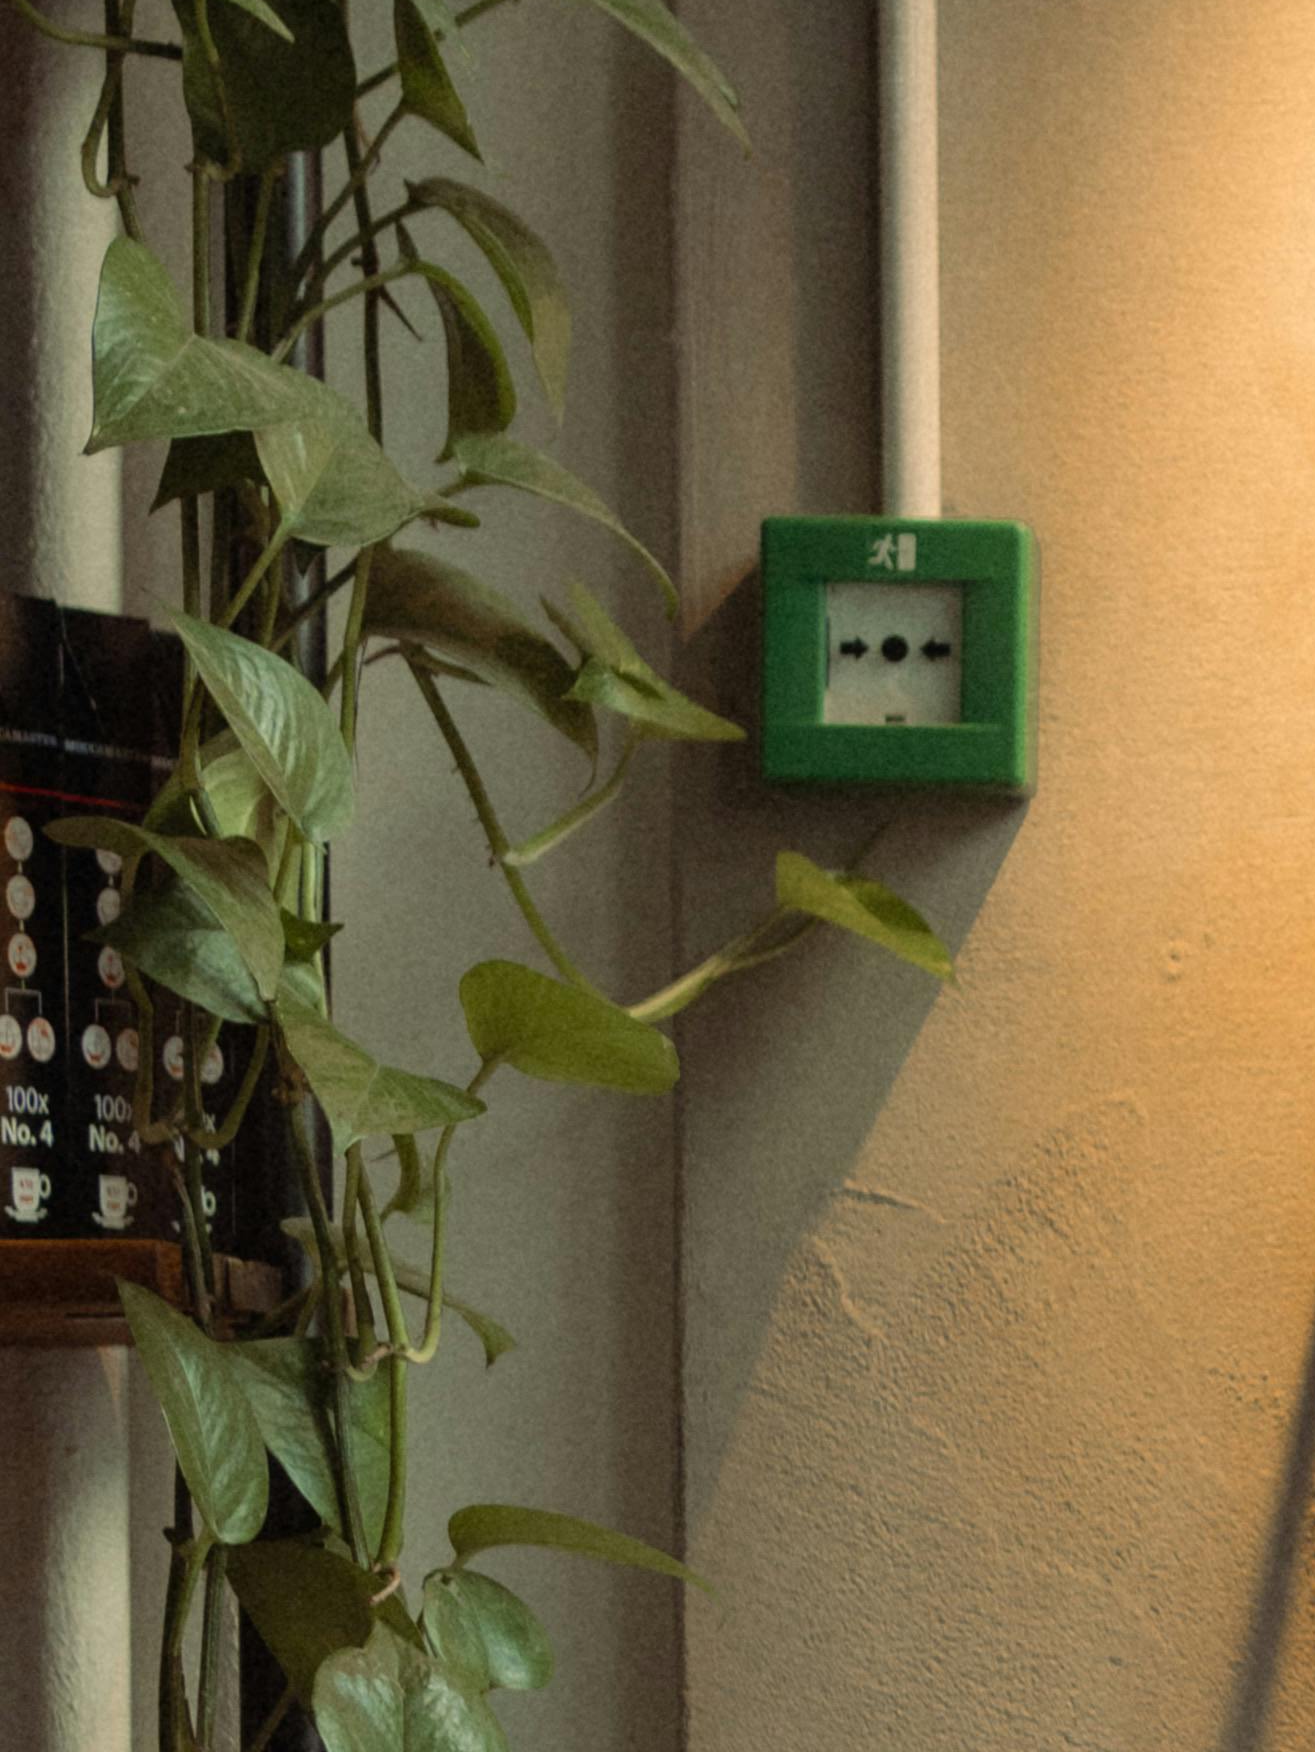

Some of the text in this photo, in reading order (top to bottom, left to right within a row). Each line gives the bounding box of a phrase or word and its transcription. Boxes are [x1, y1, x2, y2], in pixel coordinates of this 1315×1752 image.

[6, 1085, 49, 1115] 100x
[1, 1115, 53, 1147] No. 4
[89, 1123, 141, 1153] No. 4
